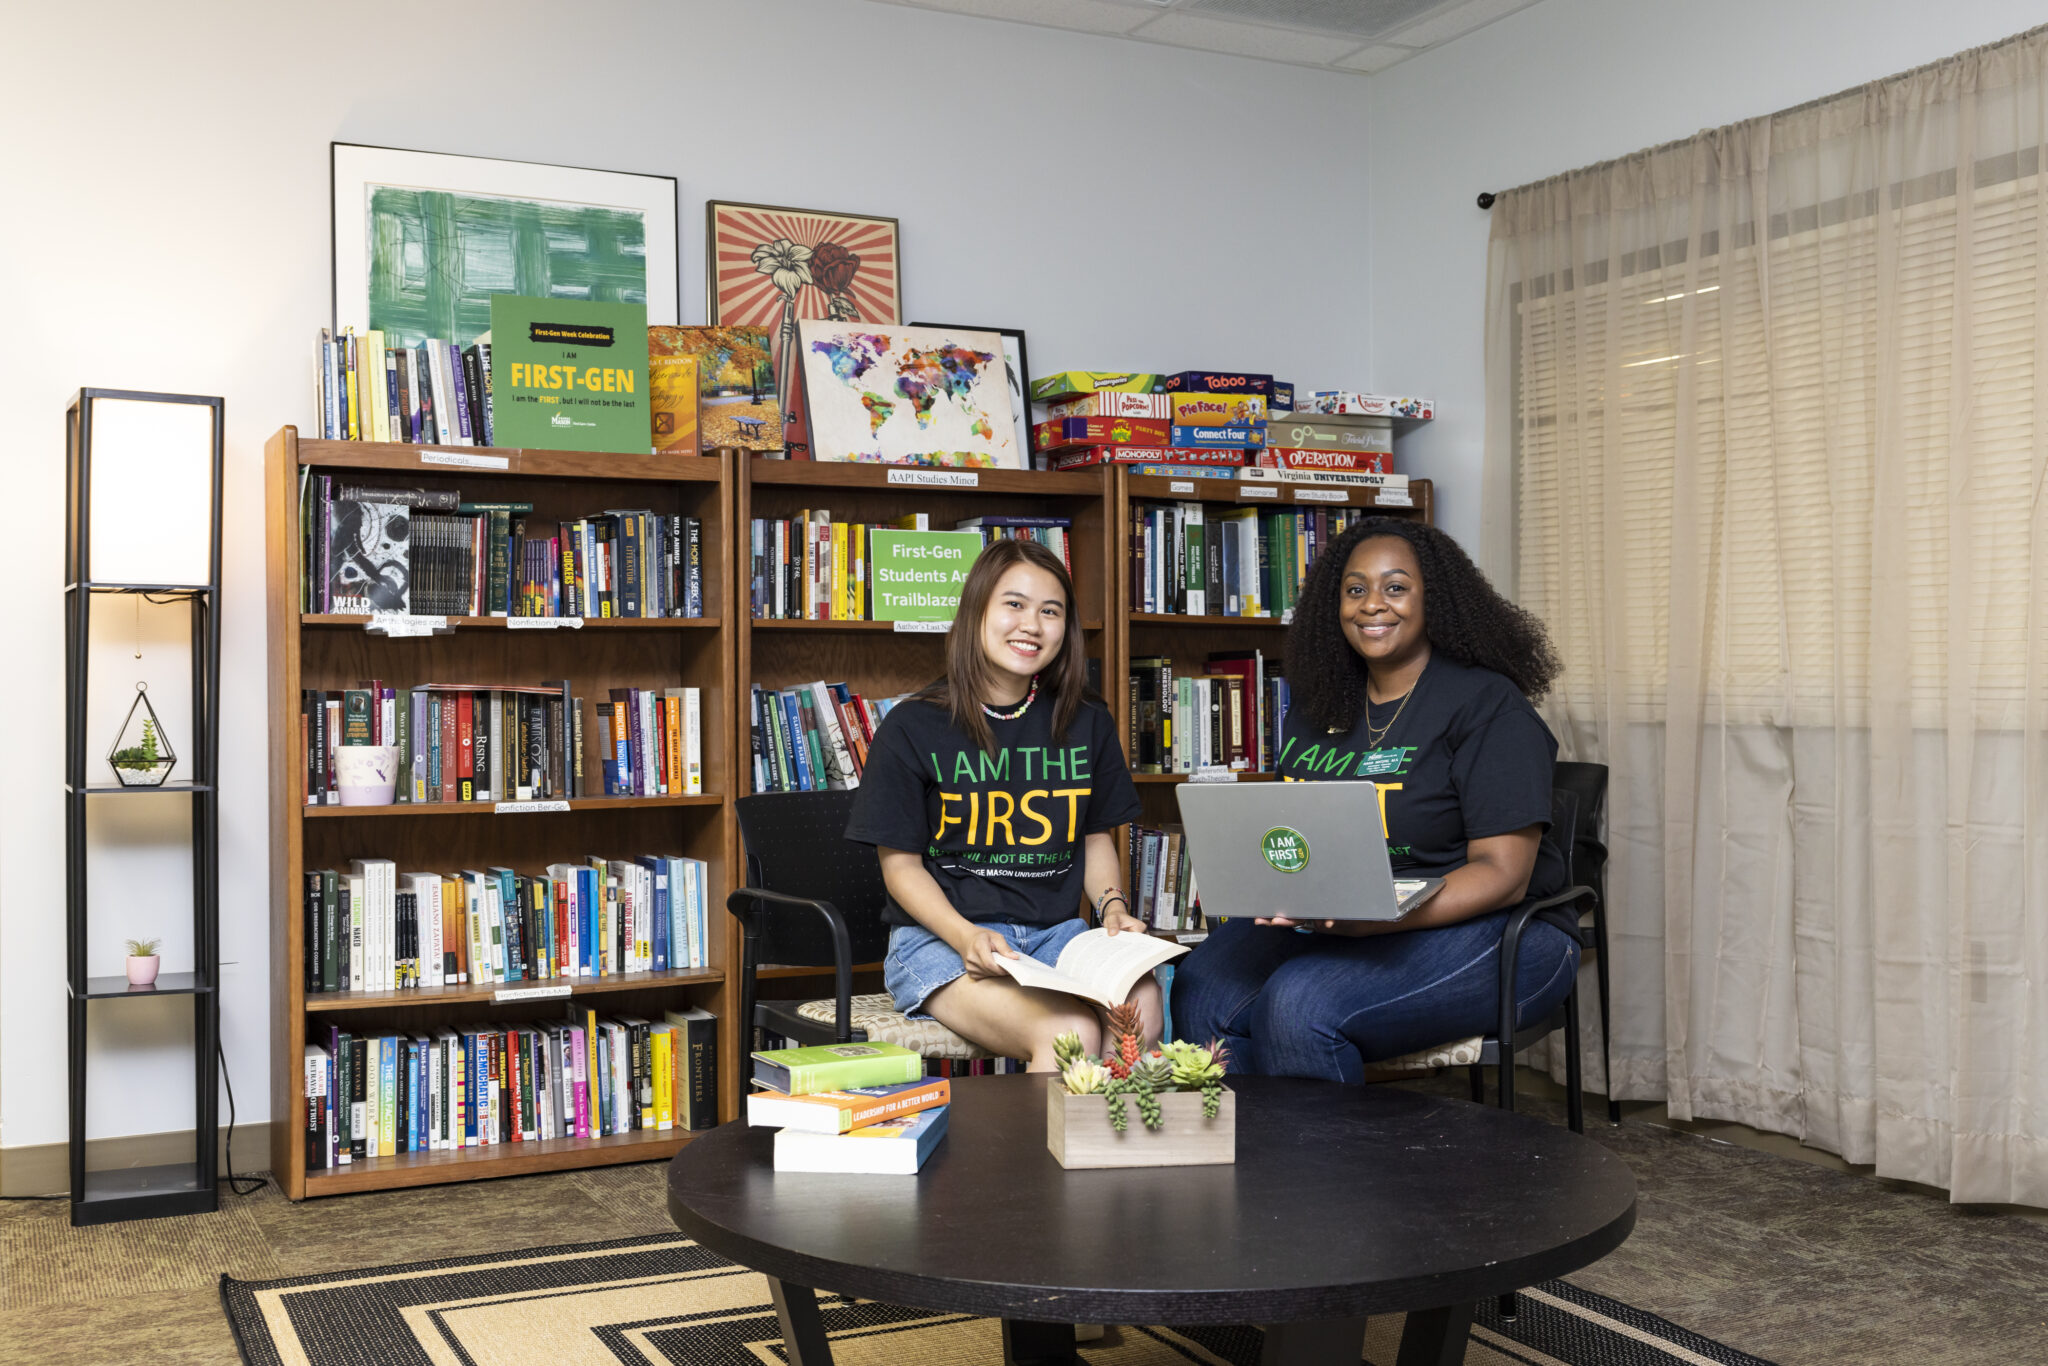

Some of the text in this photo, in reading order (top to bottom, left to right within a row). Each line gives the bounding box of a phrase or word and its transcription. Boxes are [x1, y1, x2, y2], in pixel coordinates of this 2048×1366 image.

[535, 329, 560, 337] First-Gen
[562, 330, 577, 338] Week
[511, 363, 635, 393] FIRST-GEN
[1204, 376, 1246, 390] Taboo
[400, 388, 409, 415] Dracula
[458, 392, 465, 402] My
[528, 395, 538, 403] the
[623, 400, 635, 408] last
[1178, 401, 1228, 417] Pie Face!
[1193, 428, 1246, 439] Connect Four
[1117, 450, 1160, 459] MONOPOLY
[1289, 451, 1357, 468] OPERATION
[890, 473, 976, 485] AAPI Studies Minor
[1277, 471, 1385, 485] Virginia UNIVERSITOPOLY
[1172, 484, 1192, 492] Games
[1241, 489, 1277, 497] Dictionaries
[1313, 492, 1327, 500] Study
[892, 544, 962, 559] First-Gen
[563, 551, 574, 585] CLOCKERS
[691, 567, 698, 579] WE
[879, 568, 968, 583] Students Ar
[691, 582, 699, 599] SEEK
[333, 596, 371, 607] WILD
[532, 717, 541, 740] AMOS
[792, 716, 802, 745] CLAIMING
[476, 736, 486, 771] RISING
[1292, 744, 1355, 777] AM
[770, 764, 778, 780] SILENCE
[931, 746, 1091, 783] I AM THE
[935, 788, 1092, 846] FIRST
[1270, 836, 1295, 848] I AM
[990, 853, 1057, 865] NOT BE THE
[1269, 849, 1297, 860] FIRST
[986, 869, 1056, 878] MASON UNIVERSITY
[353, 897, 361, 947] TEACHING NAKED
[368, 1058, 376, 1087] GOOD
[478, 1049, 488, 1107] DEMOCRATIC
[692, 1043, 703, 1102] FRONTIERS
[310, 1097, 316, 1108] OF
[385, 1064, 393, 1143] THE IDEA FACTORY
[853, 1091, 938, 1122] LEADERSHIP FOR A BETTER WORLD
